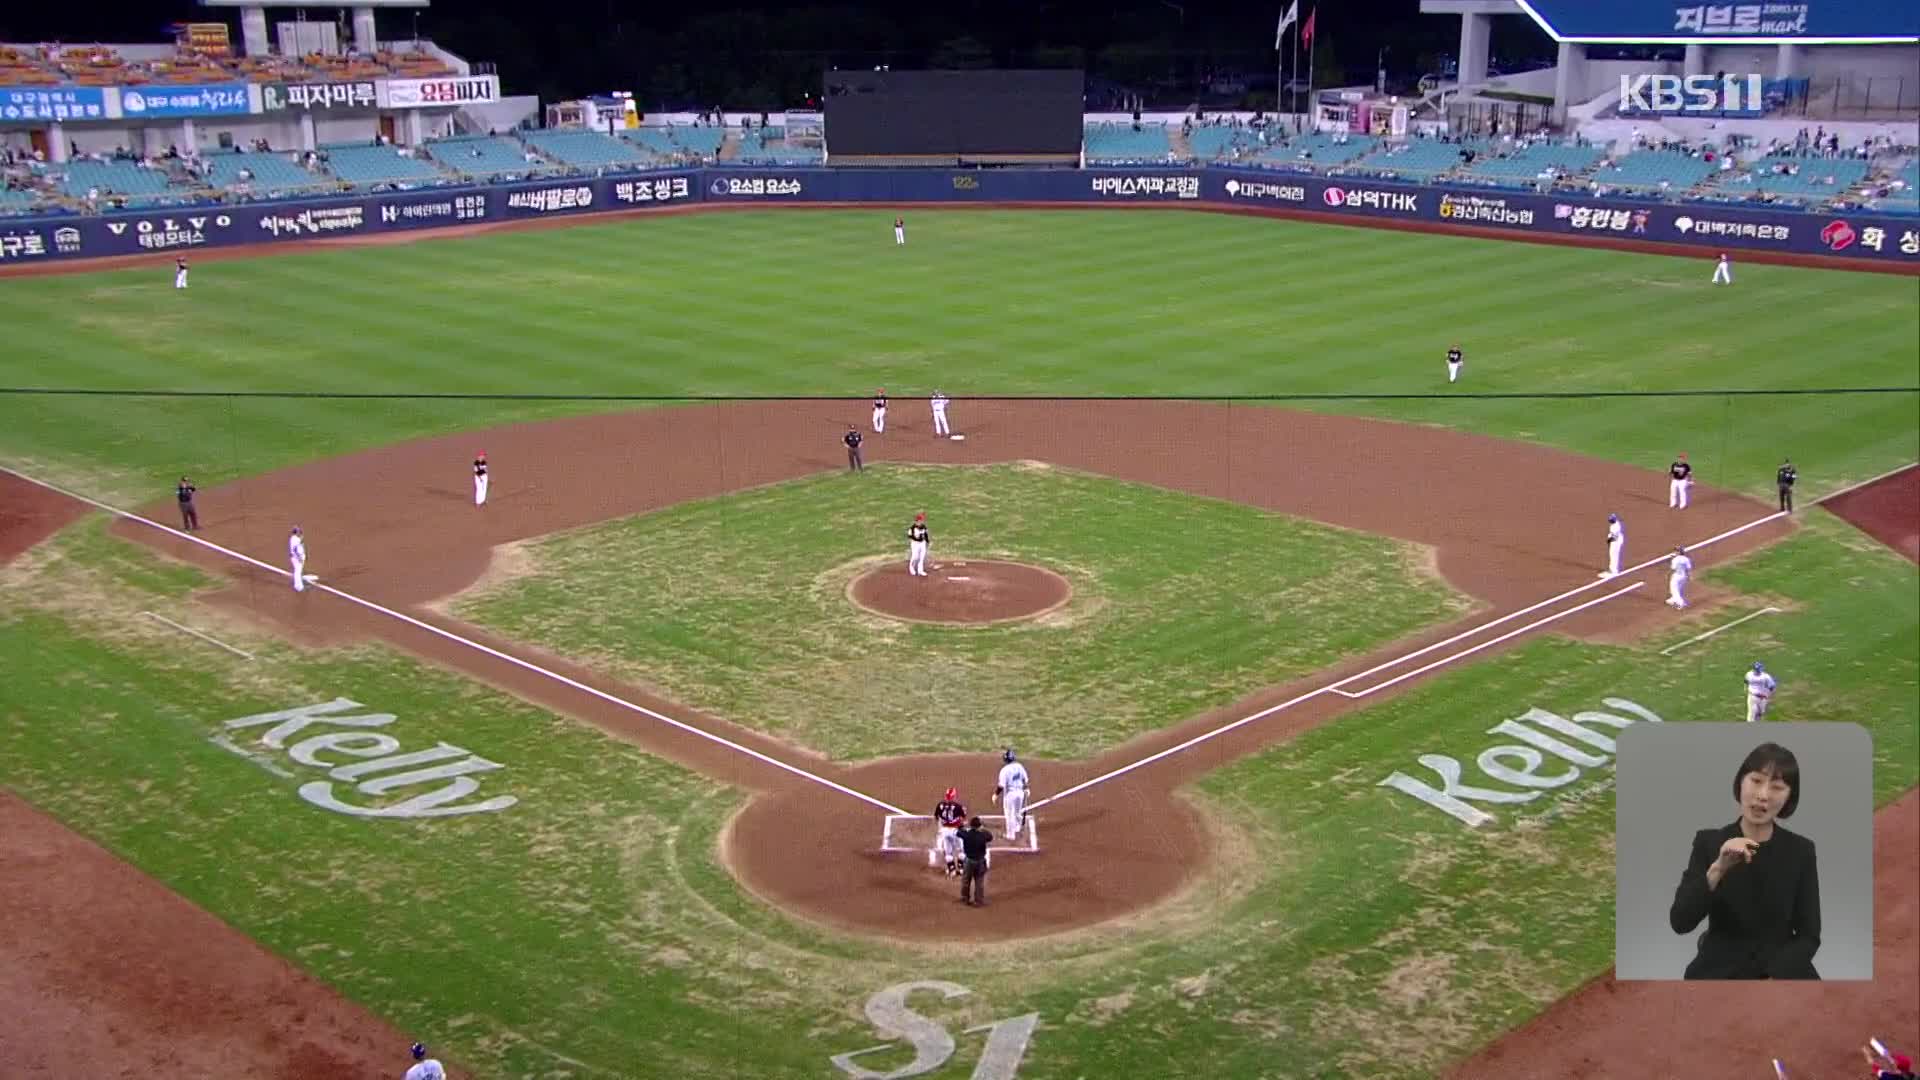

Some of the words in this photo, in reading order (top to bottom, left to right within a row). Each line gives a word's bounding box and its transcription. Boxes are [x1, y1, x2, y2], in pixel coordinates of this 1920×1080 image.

[1674, 5, 1762, 34] 지브로
[1761, 10, 1808, 33] mart
[287, 83, 377, 109] 피자마루
[615, 177, 690, 203] 백조씽크
[1240, 182, 1305, 202] 대구백화점
[138, 229, 207, 249] 태영모터스
[1694, 220, 1790, 240] 대백저축은행
[0, 233, 46, 258] 구로
[222, 697, 520, 819] Kelly
